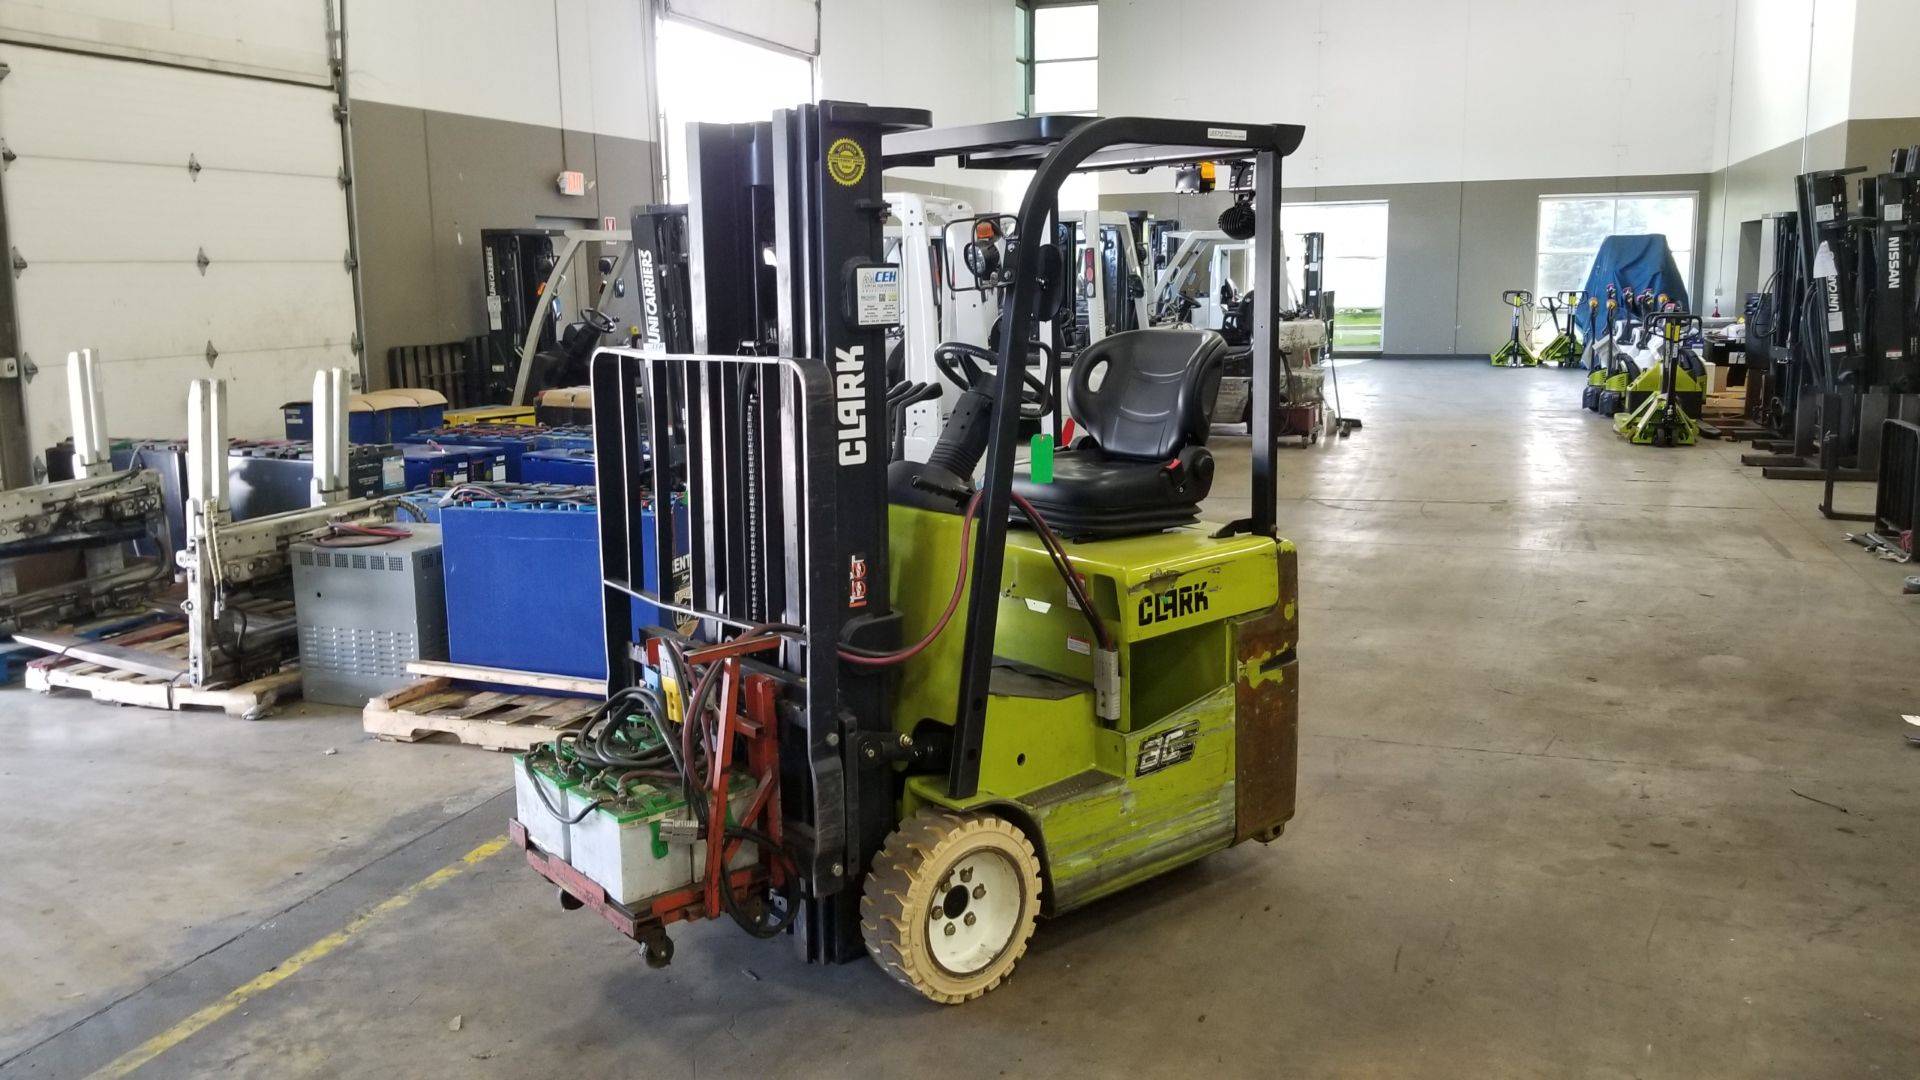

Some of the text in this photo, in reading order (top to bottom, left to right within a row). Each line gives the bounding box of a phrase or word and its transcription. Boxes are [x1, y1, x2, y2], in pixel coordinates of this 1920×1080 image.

[874, 271, 897, 283] CEH
[1888, 236, 1900, 289] NISSAN
[639, 249, 661, 344] UNICARRIERS
[1827, 275, 1840, 312] UNICAR
[835, 345, 867, 466] CLARK
[1138, 581, 1209, 627] CLARK
